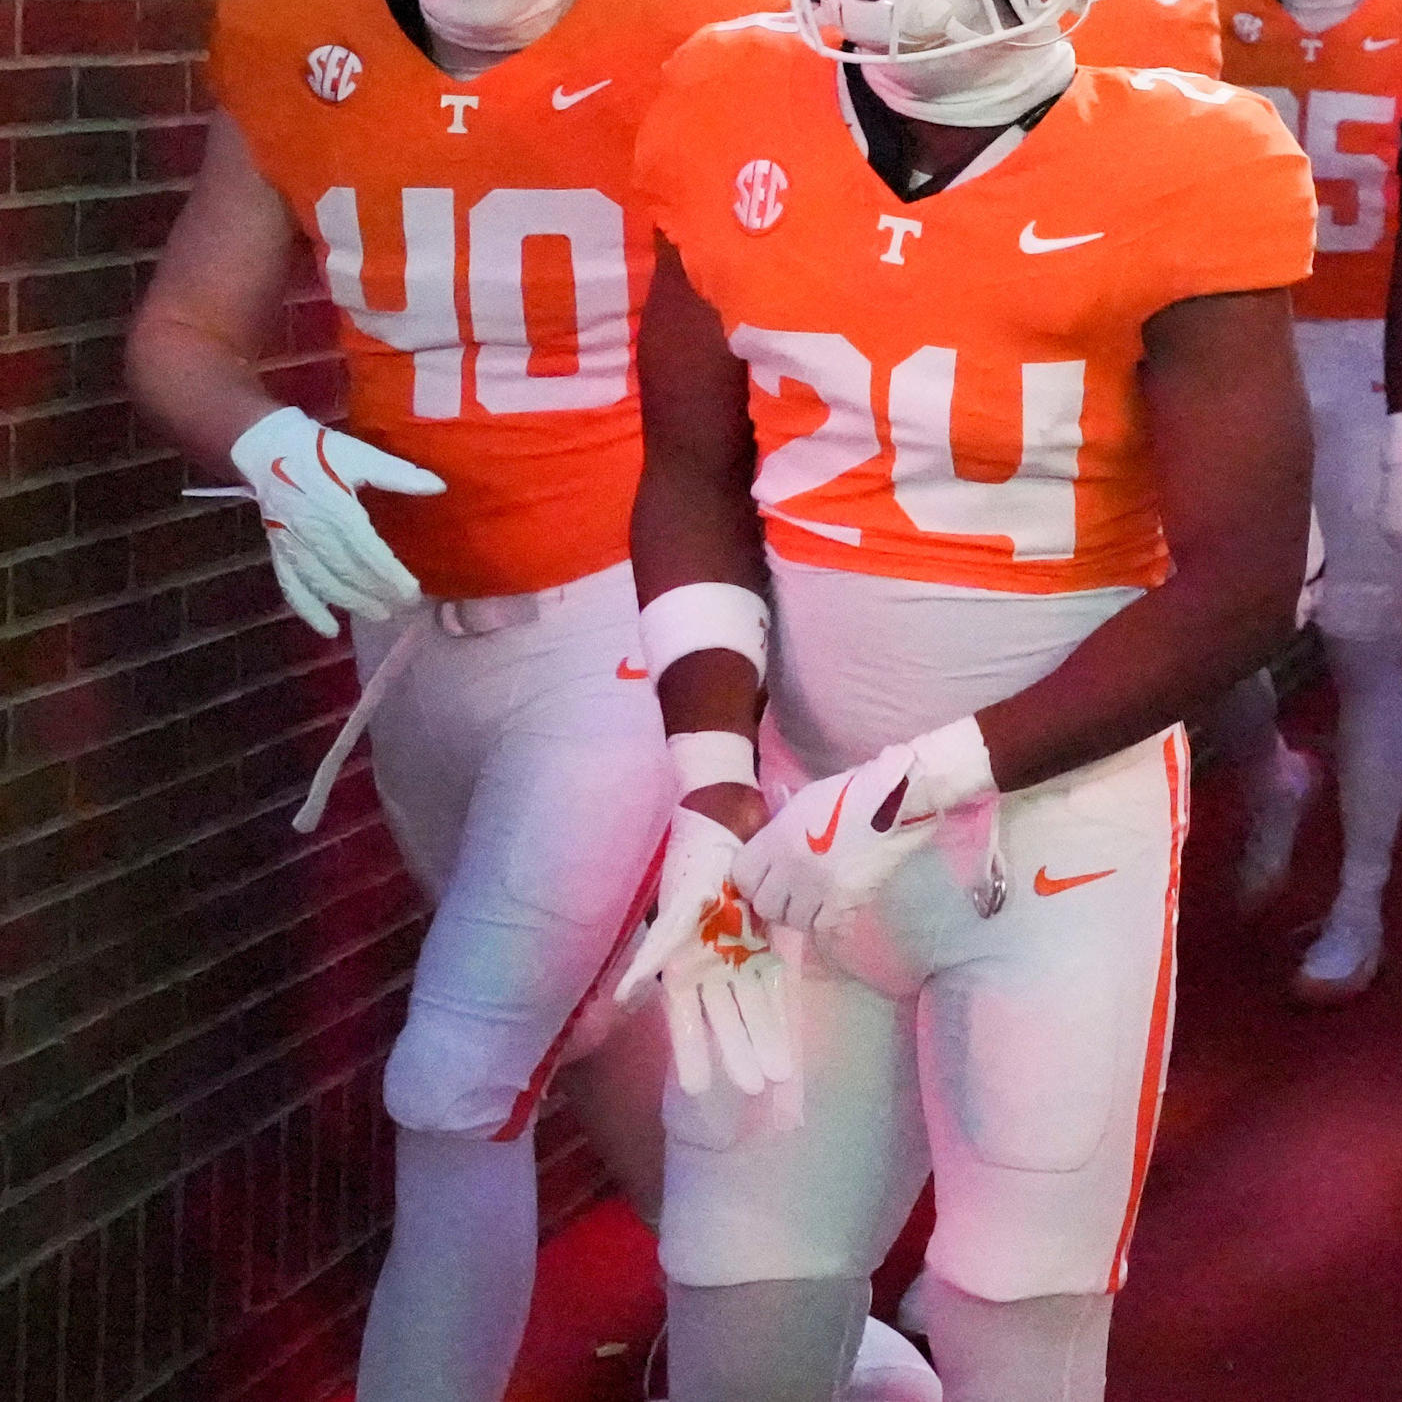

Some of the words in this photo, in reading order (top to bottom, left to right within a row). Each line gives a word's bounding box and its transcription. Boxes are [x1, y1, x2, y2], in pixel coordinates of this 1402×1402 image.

[306, 44, 363, 103] SEC
[1300, 38, 1324, 63] T
[440, 94, 480, 135] T
[733, 158, 788, 232] SEC
[877, 213, 923, 266] T
[314, 186, 631, 418] 40
[727, 322, 1088, 562] 24
